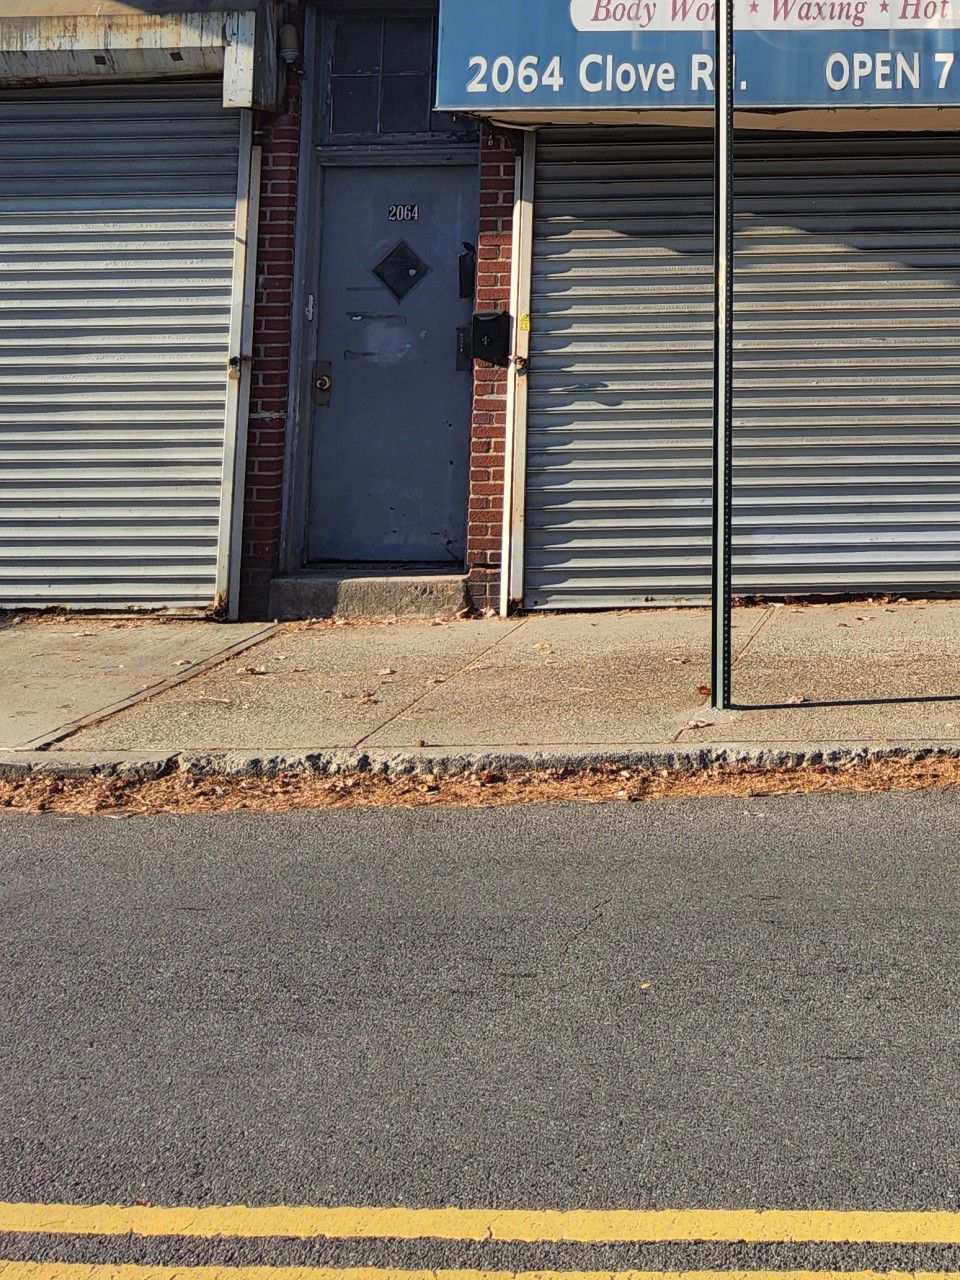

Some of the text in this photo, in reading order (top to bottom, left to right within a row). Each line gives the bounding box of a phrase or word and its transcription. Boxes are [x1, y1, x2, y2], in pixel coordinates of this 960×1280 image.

[466, 53, 748, 93] 2064 Clove R.
[824, 52, 920, 91] OPEN
[934, 53, 955, 90] 7
[388, 204, 420, 221] 2064
